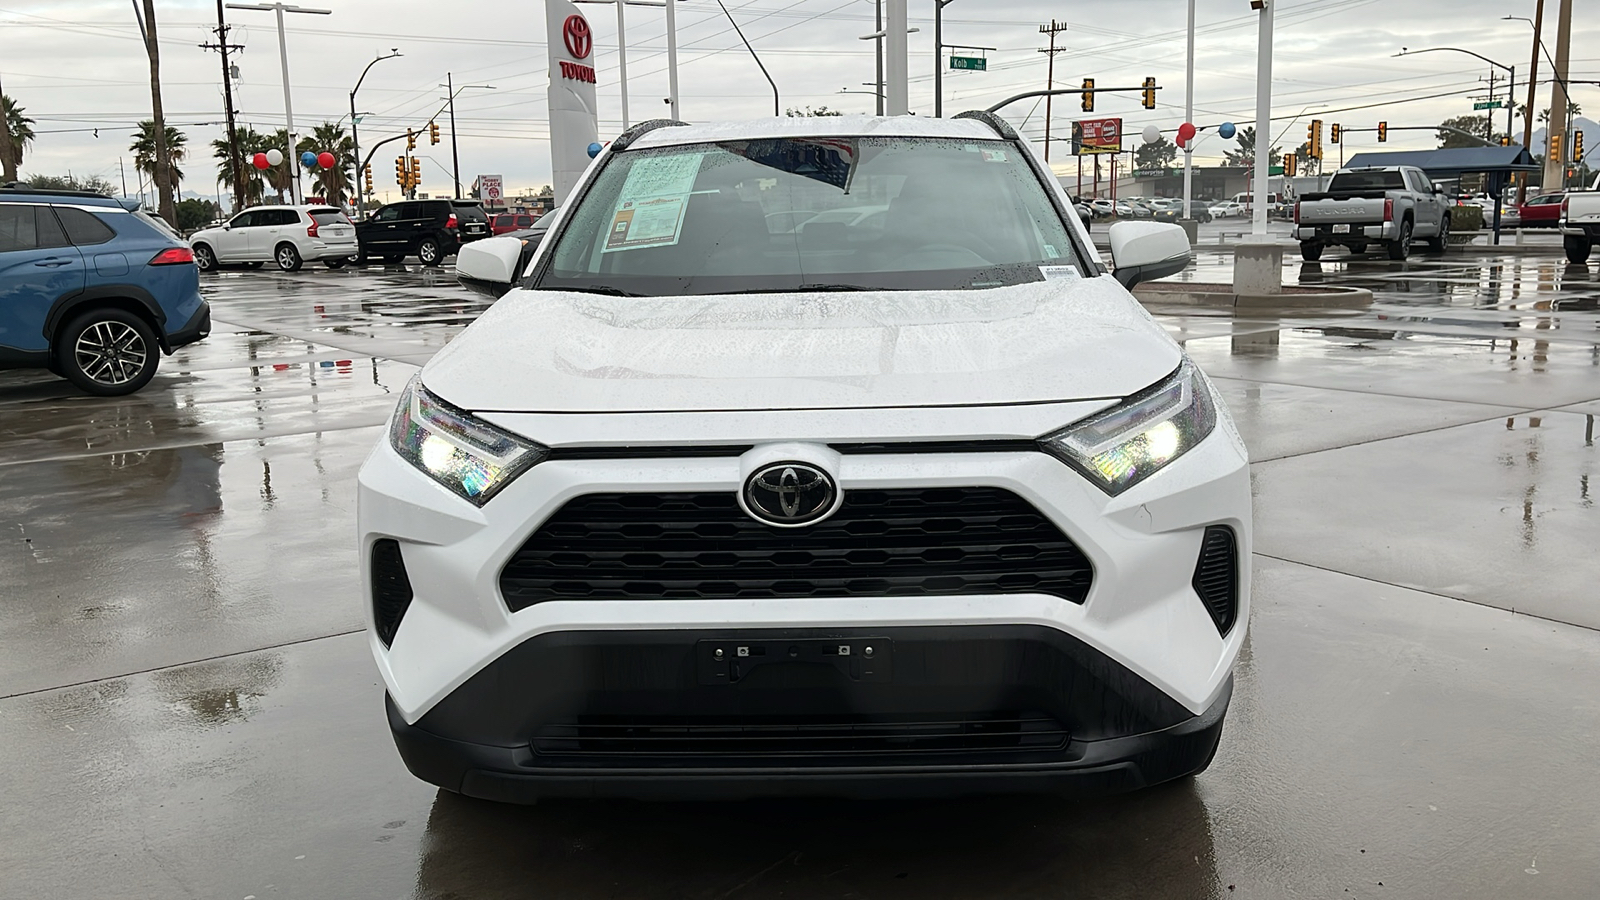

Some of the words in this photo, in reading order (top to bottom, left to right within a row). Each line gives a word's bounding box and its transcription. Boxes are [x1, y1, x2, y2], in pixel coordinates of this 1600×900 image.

[954, 58, 968, 68] Kolb
[559, 61, 597, 84] TOYOTA
[1133, 169, 1165, 177] enterprise
[1316, 207, 1366, 215] TUNDRA
